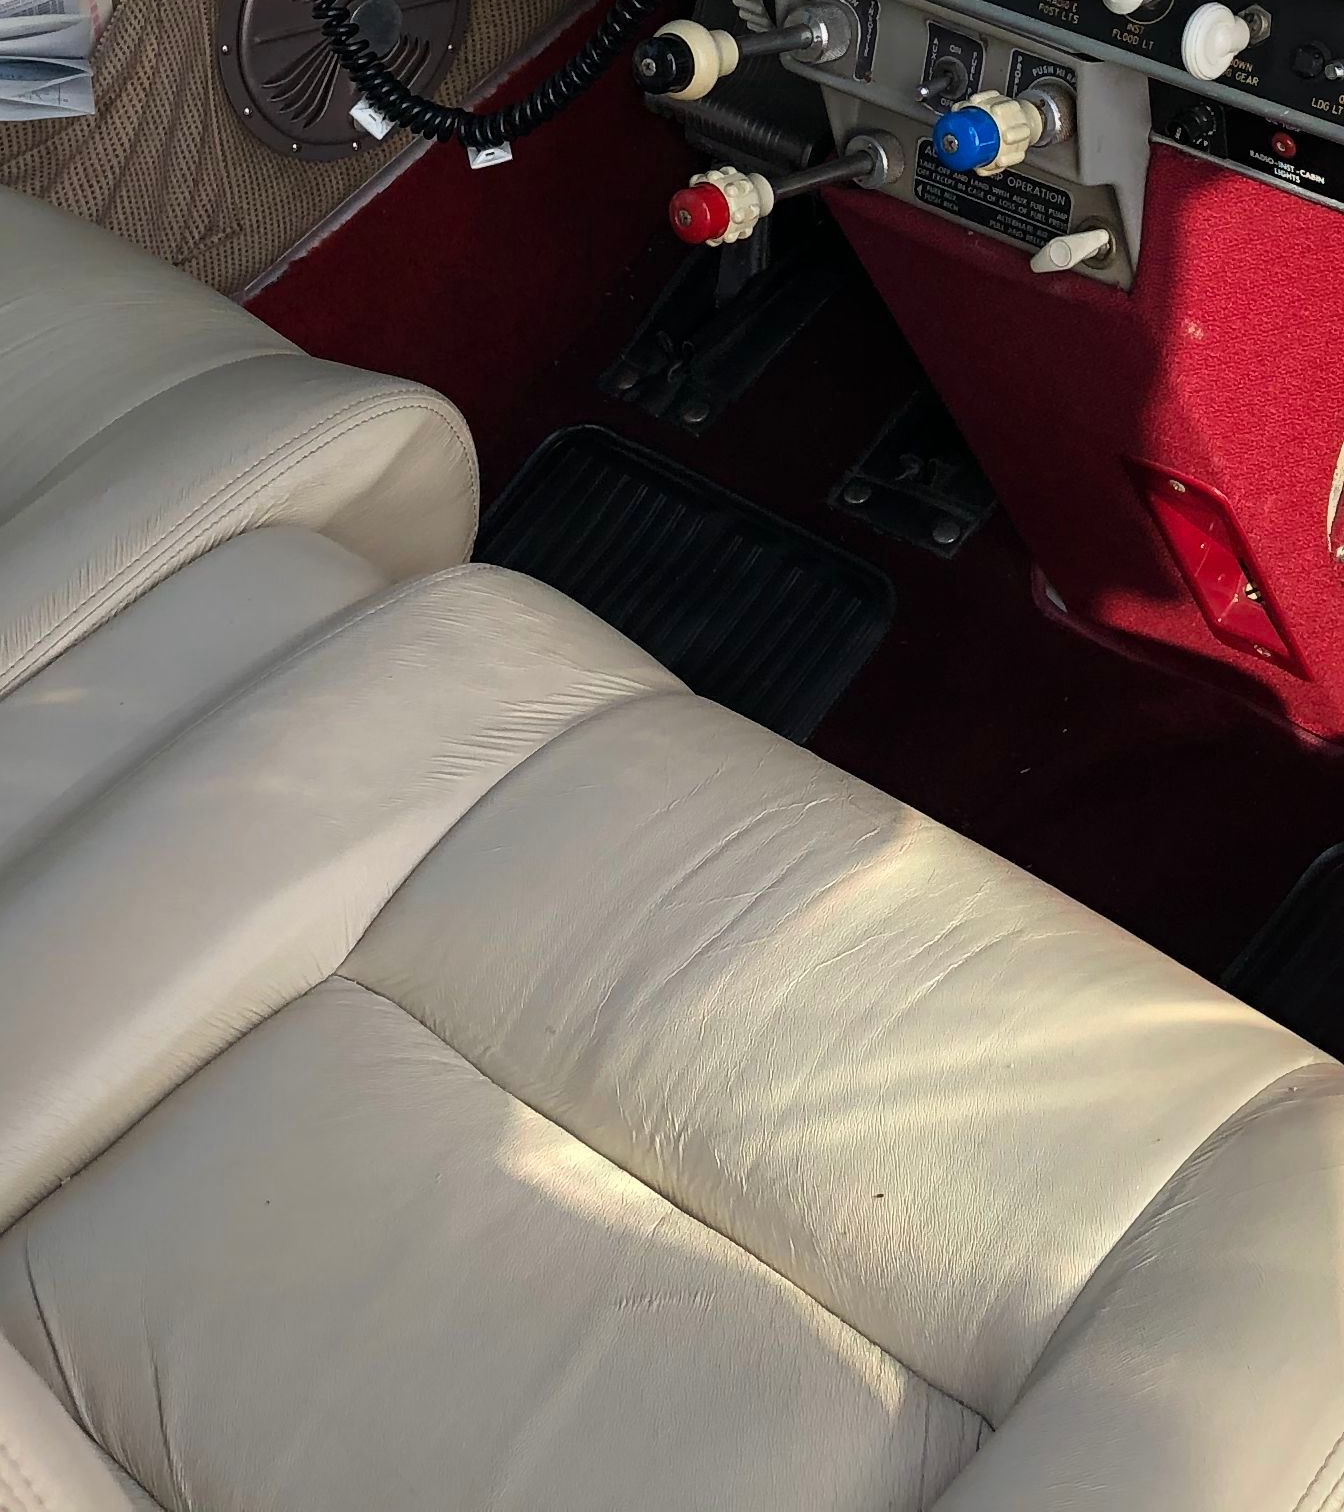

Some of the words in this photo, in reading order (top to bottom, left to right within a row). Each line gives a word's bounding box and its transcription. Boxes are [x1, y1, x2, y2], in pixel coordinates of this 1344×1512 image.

[1038, 3, 1059, 18] POST
[1062, 10, 1080, 24] LTS
[1127, 23, 1145, 33] INST
[1112, 29, 1139, 45] FLOOD
[1141, 39, 1154, 51] LT
[1235, 72, 1259, 86] GEAR
[1311, 97, 1329, 111] LDG
[1332, 103, 1343, 115] LT
[1274, 167, 1301, 184] LIGHTS
[1007, 176, 1066, 206] OPERATION
